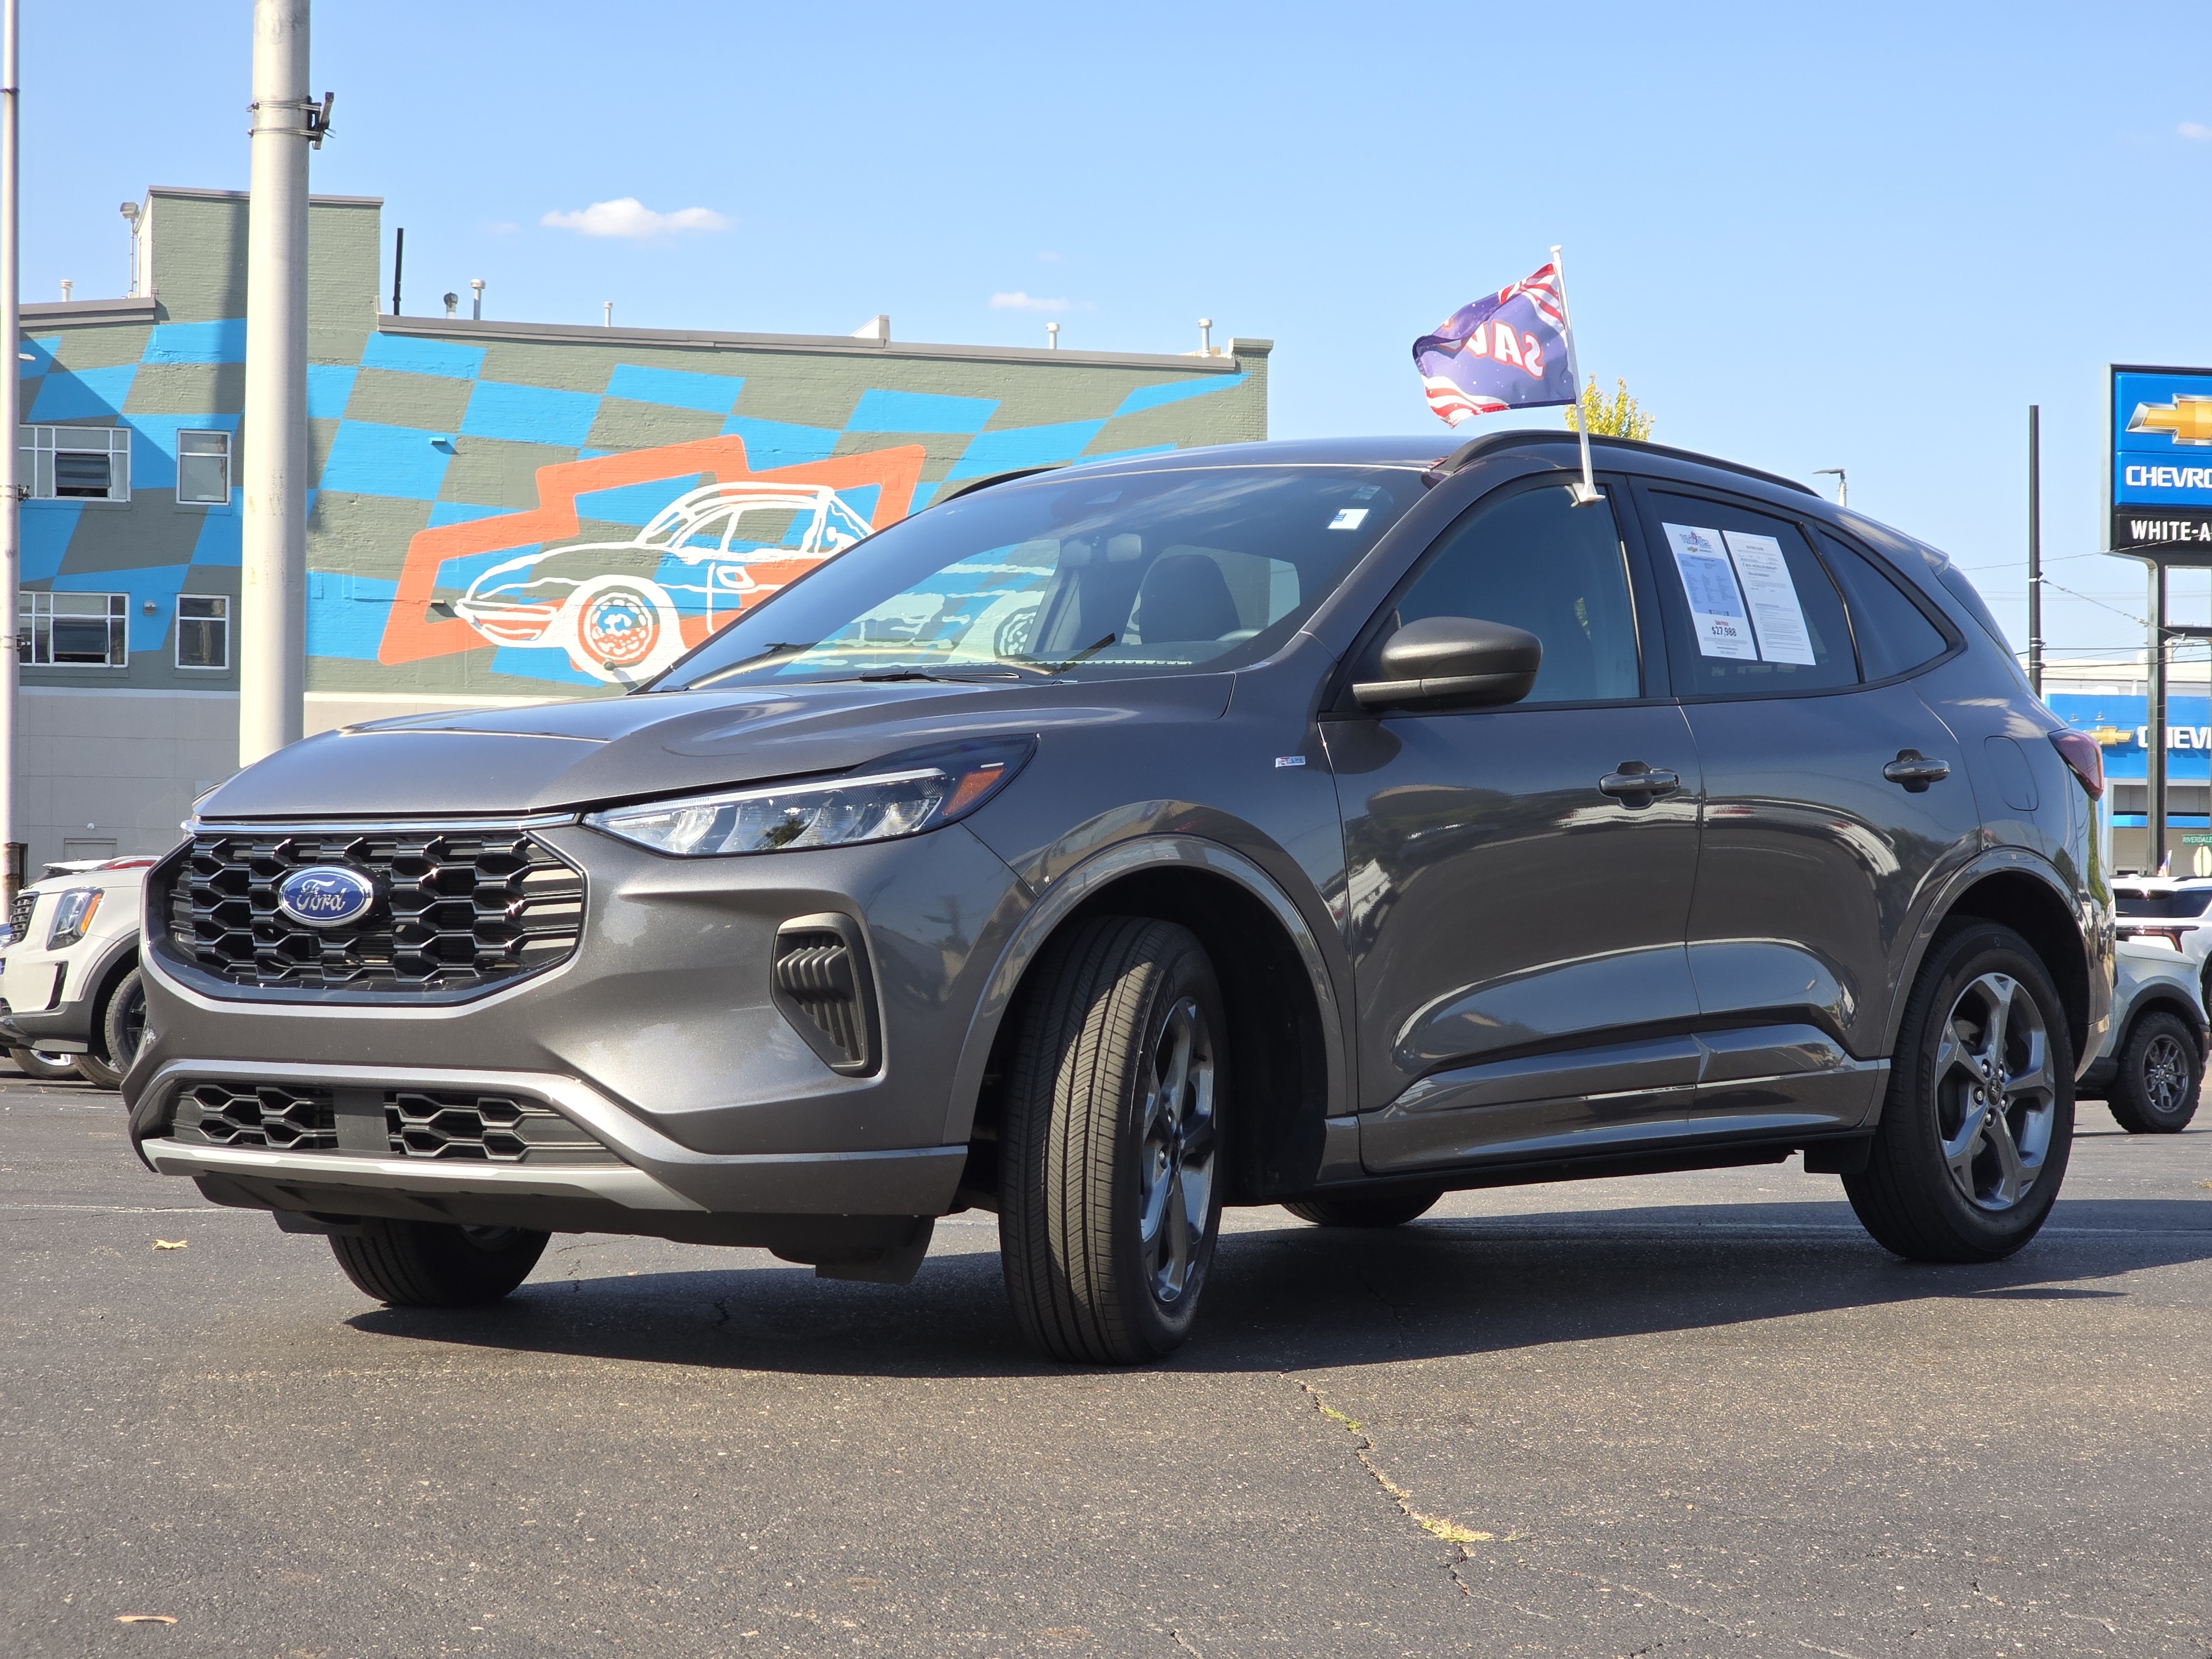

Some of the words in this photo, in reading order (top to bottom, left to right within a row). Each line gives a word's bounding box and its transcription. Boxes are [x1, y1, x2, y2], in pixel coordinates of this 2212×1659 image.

[2131, 520, 2212, 541] WHITE-A
[1712, 625, 1736, 637] $27,988
[296, 879, 347, 911] Ford
